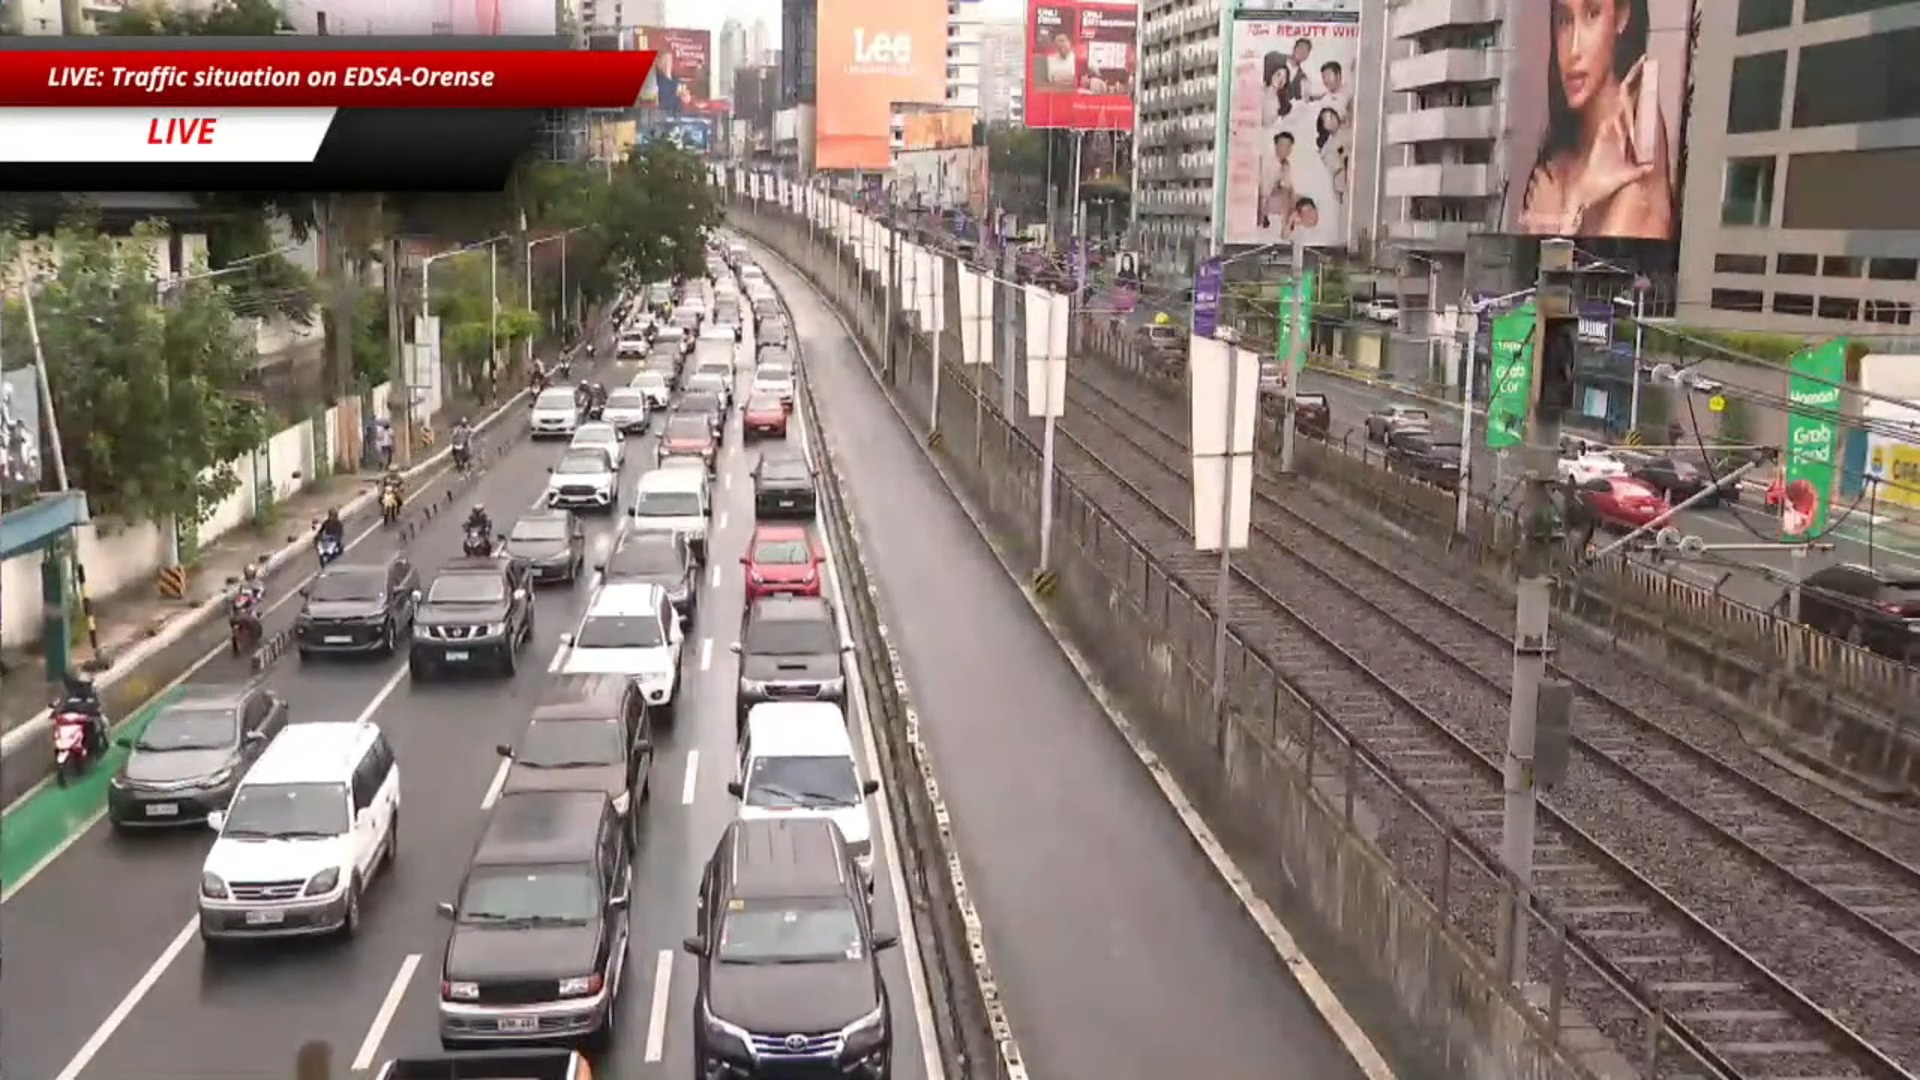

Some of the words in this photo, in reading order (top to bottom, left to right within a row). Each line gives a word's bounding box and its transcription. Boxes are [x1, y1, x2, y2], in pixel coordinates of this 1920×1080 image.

[1277, 24, 1327, 37] BEAUTY
[853, 26, 912, 64] Lee
[1496, 362, 1525, 379] Grab
[1793, 423, 1831, 445] Grab
